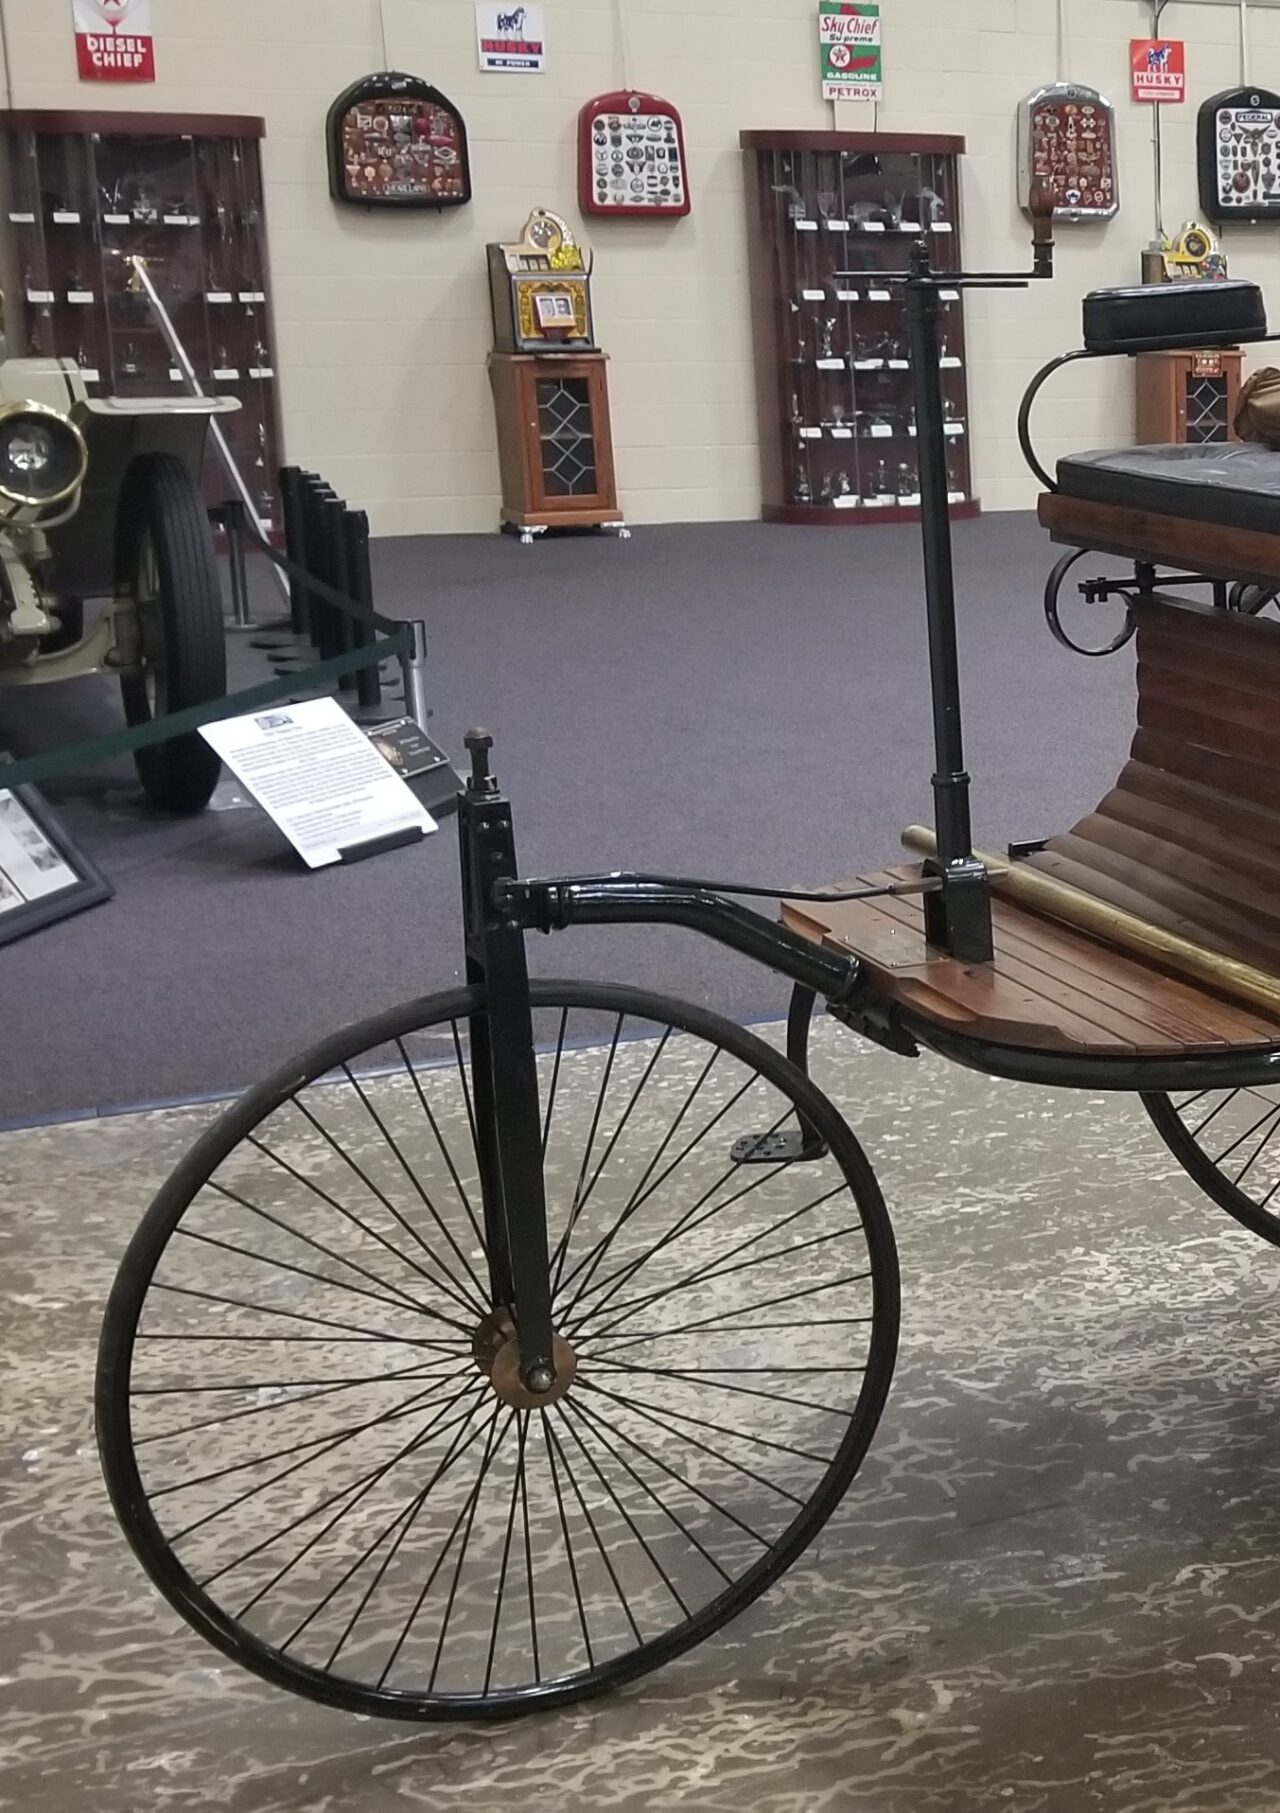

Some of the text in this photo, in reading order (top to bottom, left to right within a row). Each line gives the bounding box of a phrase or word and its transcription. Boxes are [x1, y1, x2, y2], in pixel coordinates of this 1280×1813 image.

[821, 16, 879, 35] Sky Chief
[86, 34, 146, 53] DIESEL
[829, 33, 873, 43] Supreme
[92, 52, 143, 67] CHIEF
[826, 72, 877, 81] GASOLINE
[1136, 74, 1181, 85] HUSKY
[829, 87, 877, 98] PETROX
